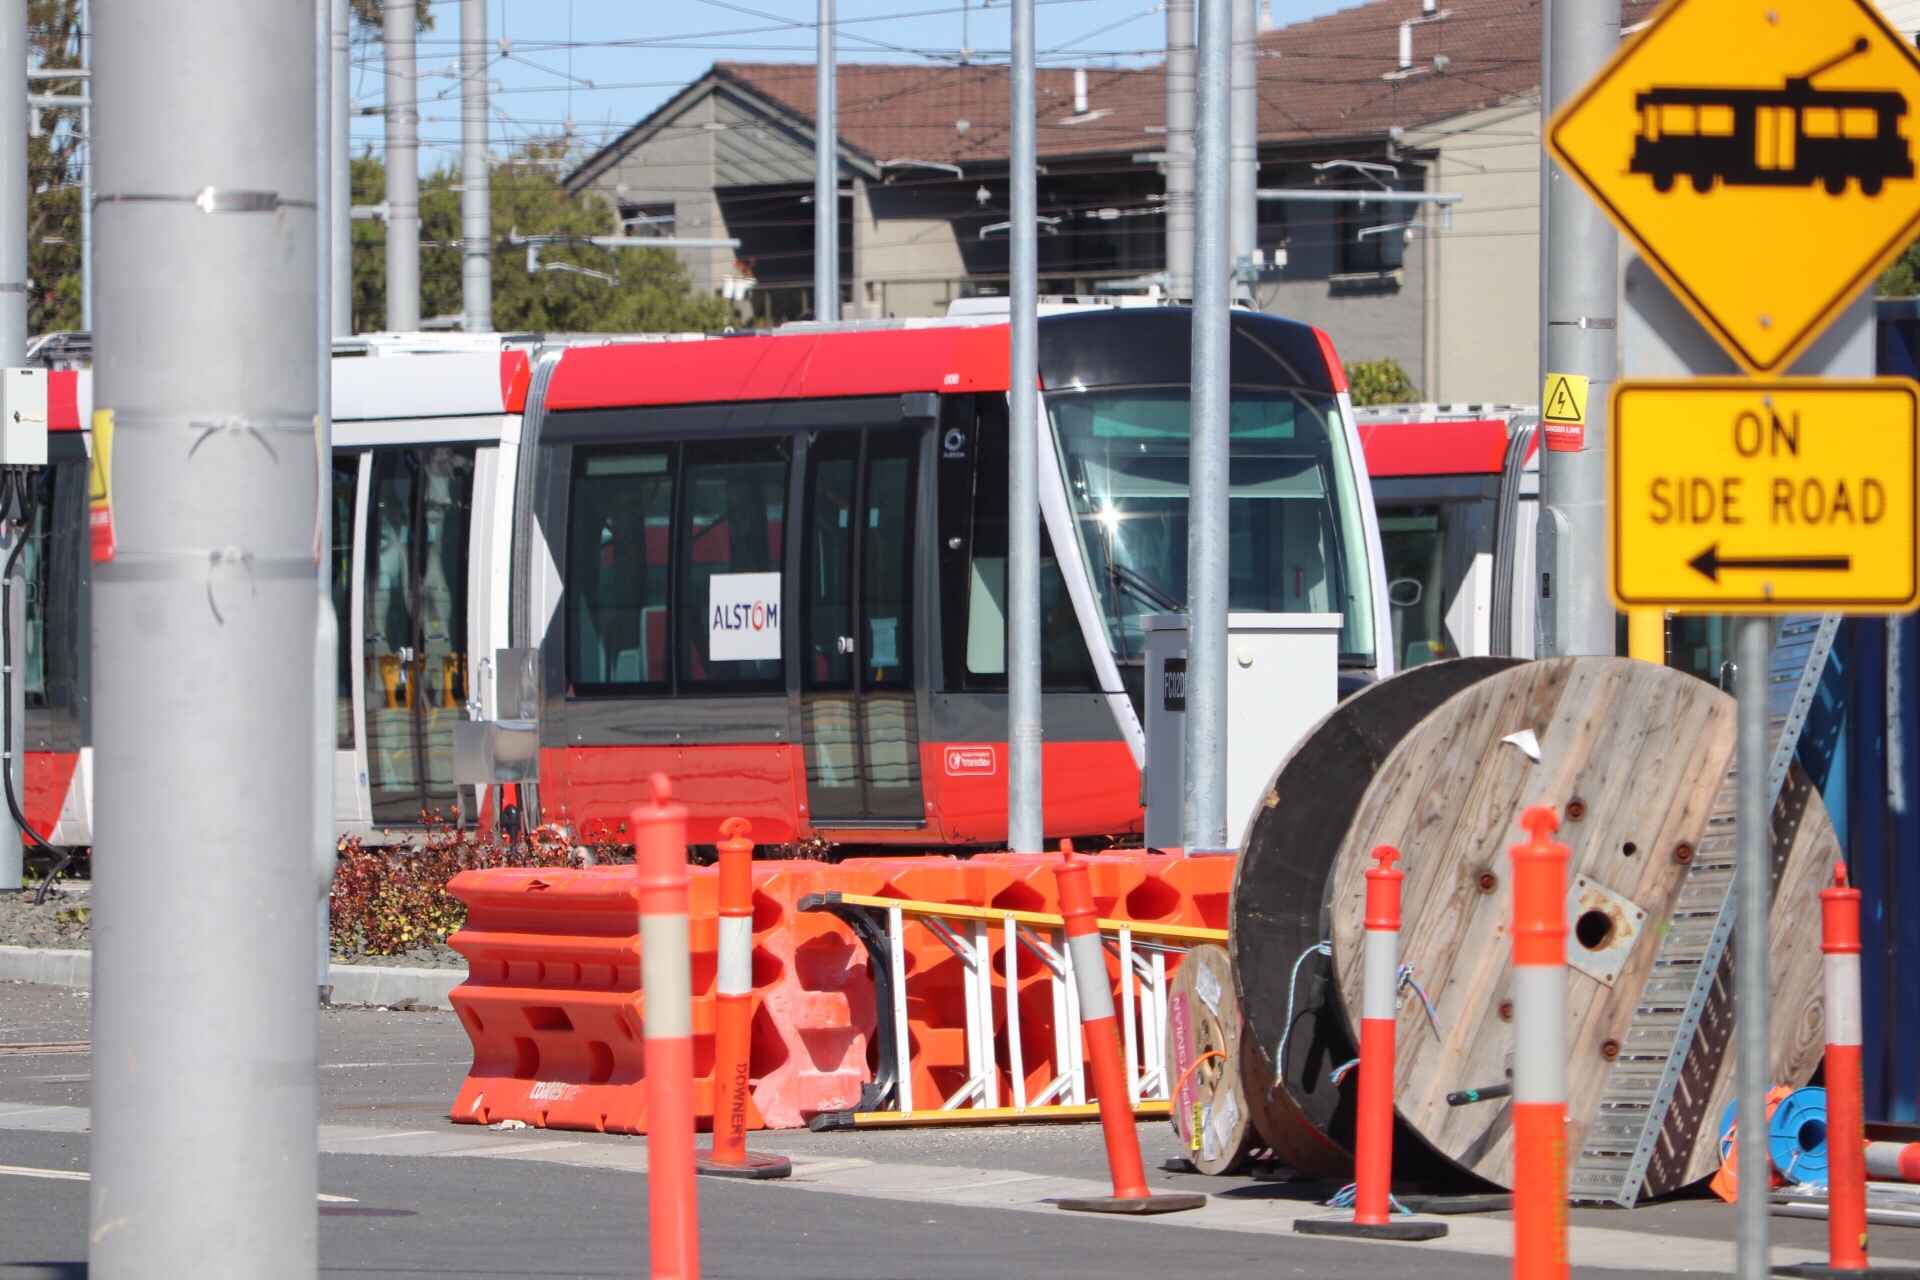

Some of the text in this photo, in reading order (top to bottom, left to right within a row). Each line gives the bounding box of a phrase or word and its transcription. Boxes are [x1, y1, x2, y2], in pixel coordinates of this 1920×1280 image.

[1545, 425, 1581, 434] DANGER LIVE
[1733, 410, 1800, 458] ON
[1649, 477, 1886, 525] SIDE ROAD
[713, 600, 777, 632] ALSTOM
[1165, 671, 1186, 699] FC02D
